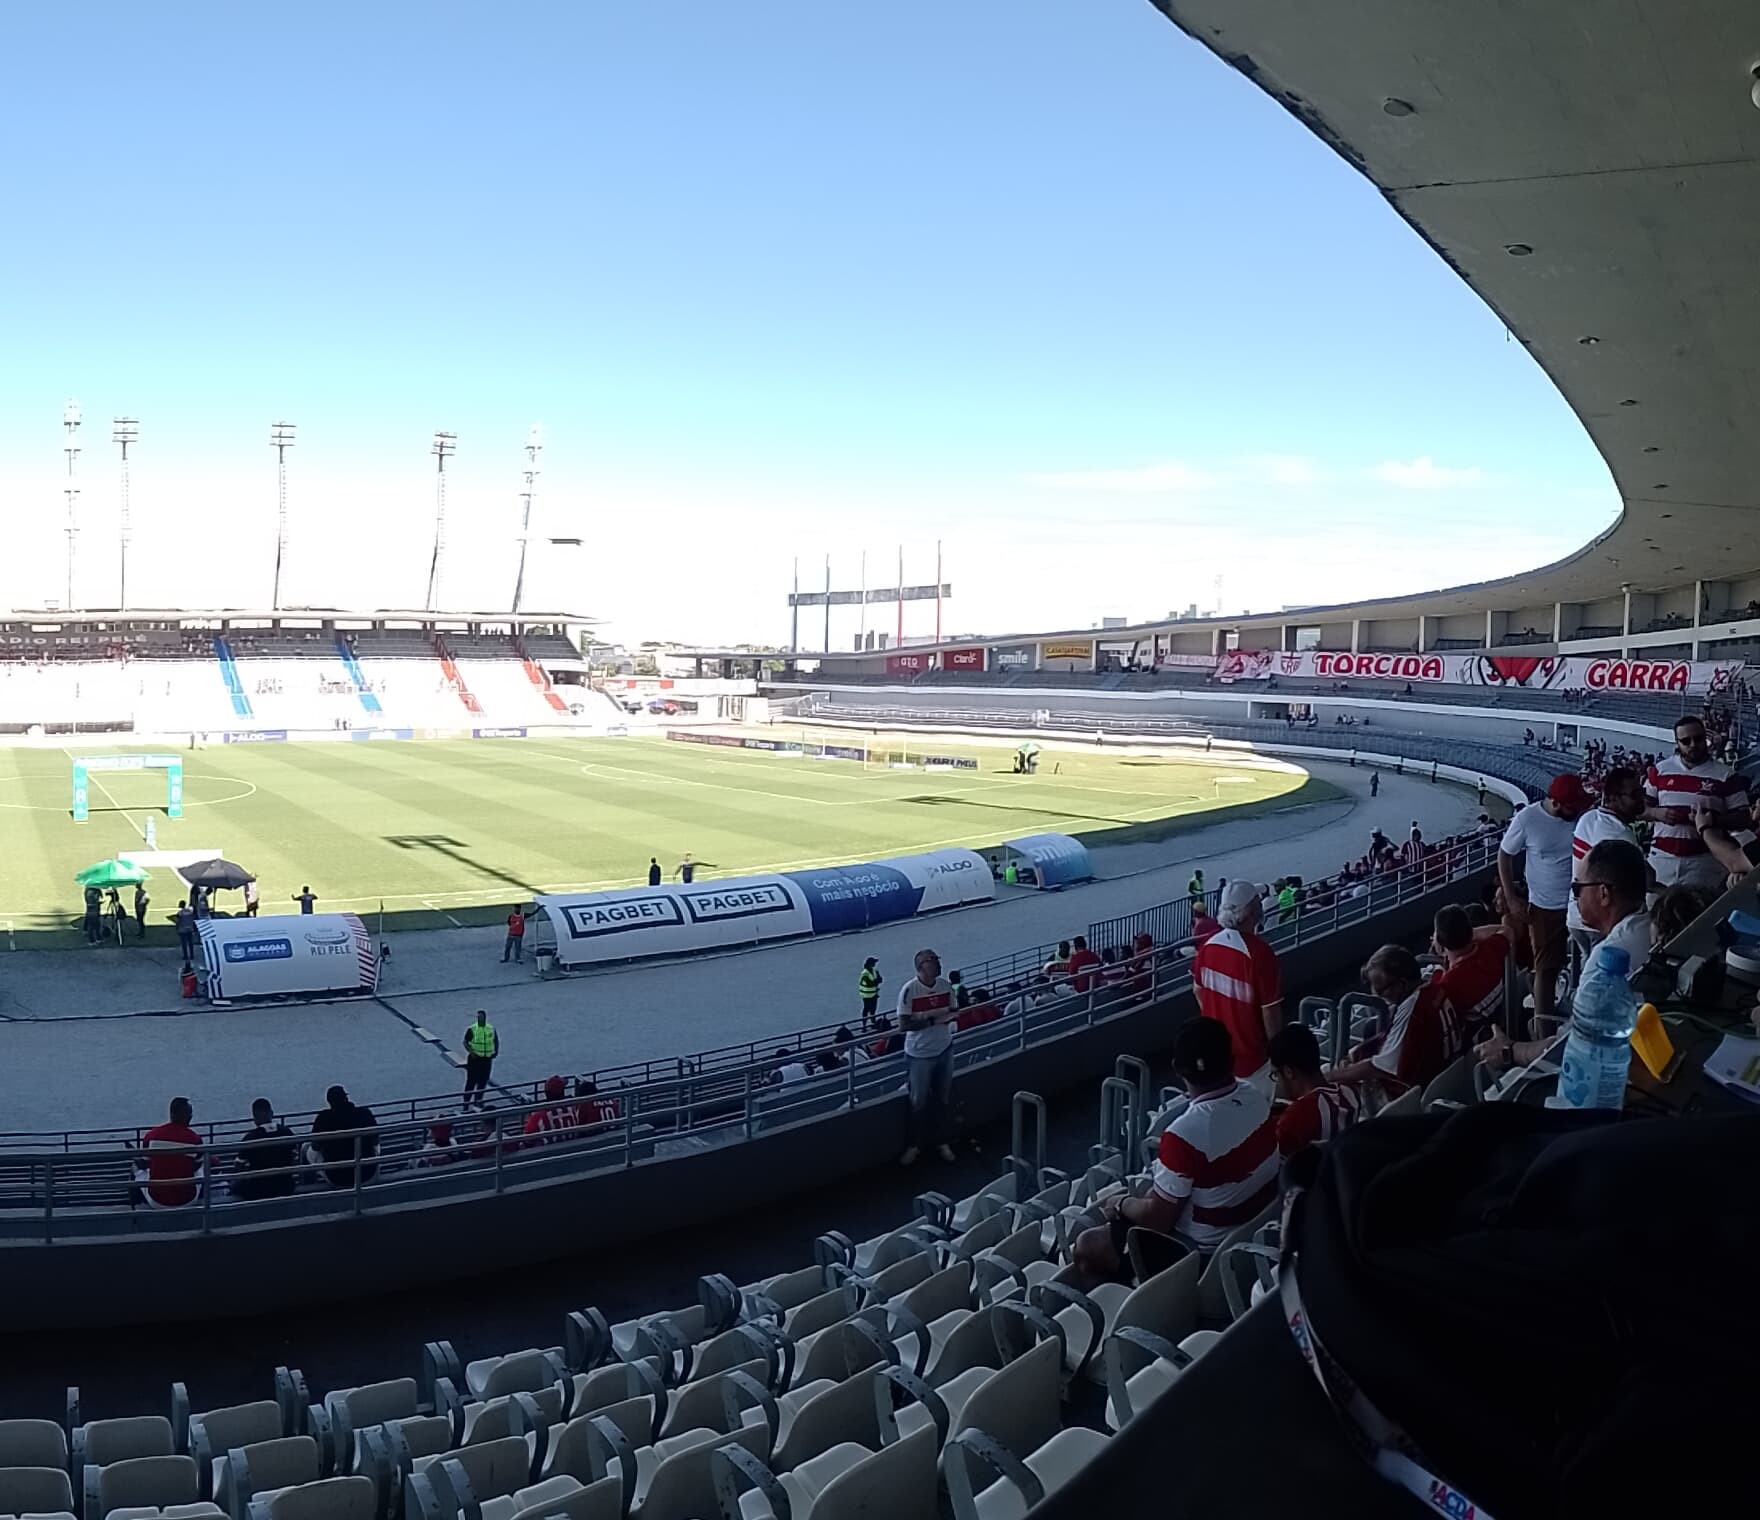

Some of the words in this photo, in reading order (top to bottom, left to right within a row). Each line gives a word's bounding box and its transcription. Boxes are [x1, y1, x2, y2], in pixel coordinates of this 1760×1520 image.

[56, 636, 88, 645] REI
[98, 633, 148, 645] PELÉ
[998, 650, 1029, 665] smile
[1314, 653, 1445, 680] TORCIDA
[1586, 660, 1689, 691] GARRA
[698, 889, 777, 912] PAGBET
[579, 901, 666, 925] PAGBET
[310, 945, 327, 957] REI
